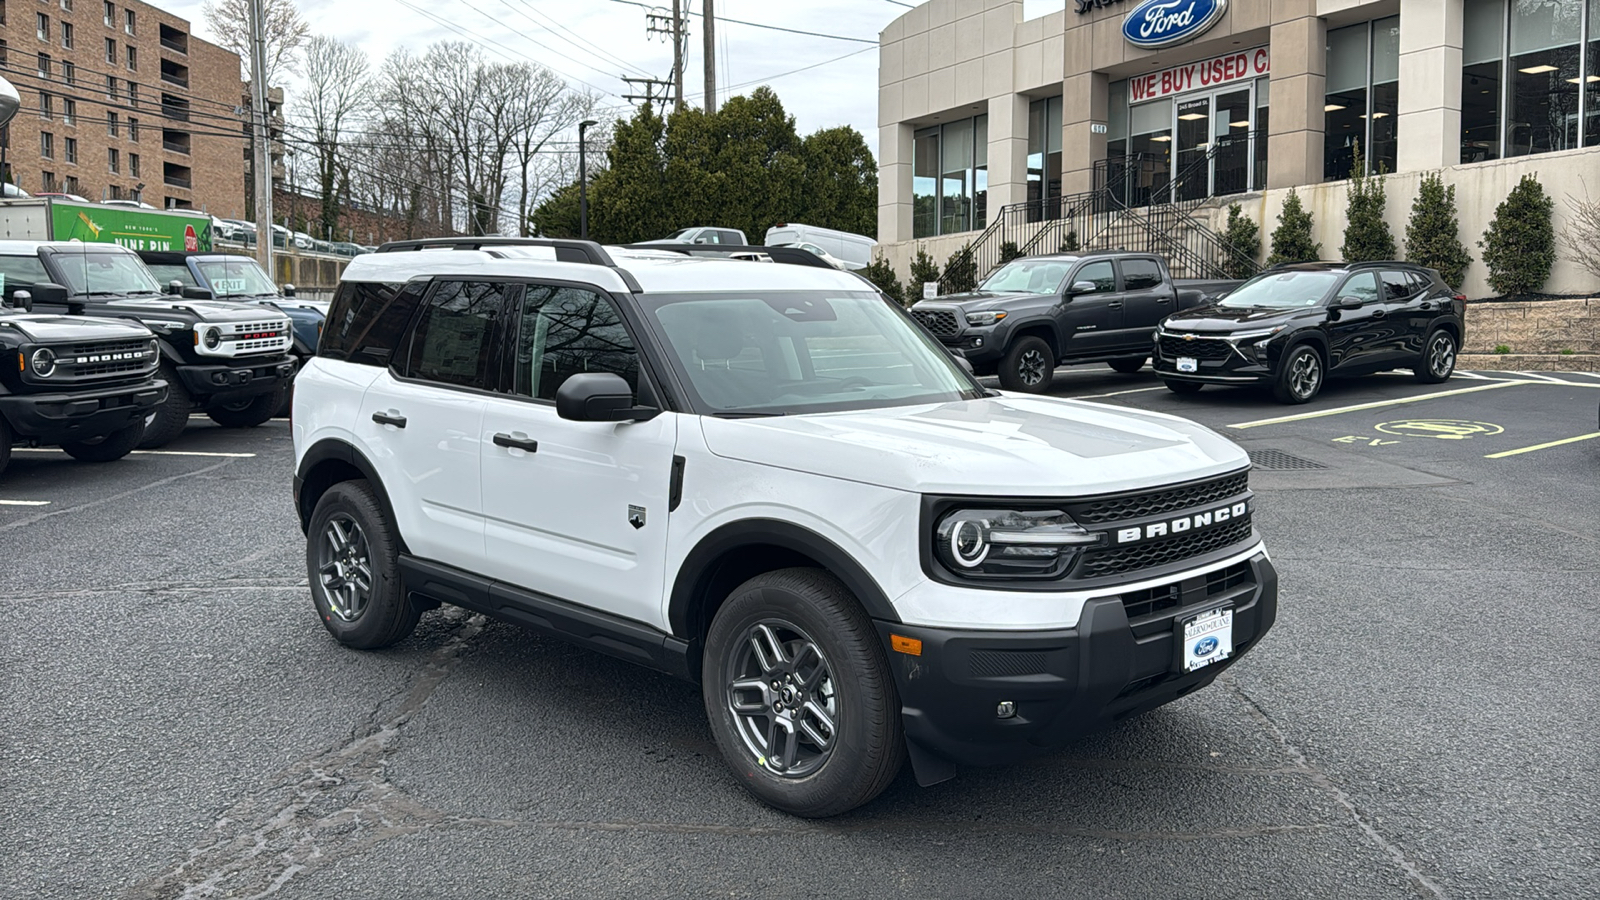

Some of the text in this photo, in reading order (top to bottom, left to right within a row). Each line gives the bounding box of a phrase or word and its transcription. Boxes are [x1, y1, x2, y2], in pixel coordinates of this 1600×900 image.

[1140, 1, 1194, 37] Ford
[1132, 75, 1156, 101] WE
[1161, 65, 1195, 94] BUY
[1200, 54, 1248, 86] USED
[185, 235, 198, 249] STOP
[221, 280, 242, 289] EXIT
[244, 332, 276, 340] FORD
[77, 352, 142, 363] BRONCO
[1117, 502, 1246, 543] BRONCO
[1198, 639, 1216, 655] Ford
